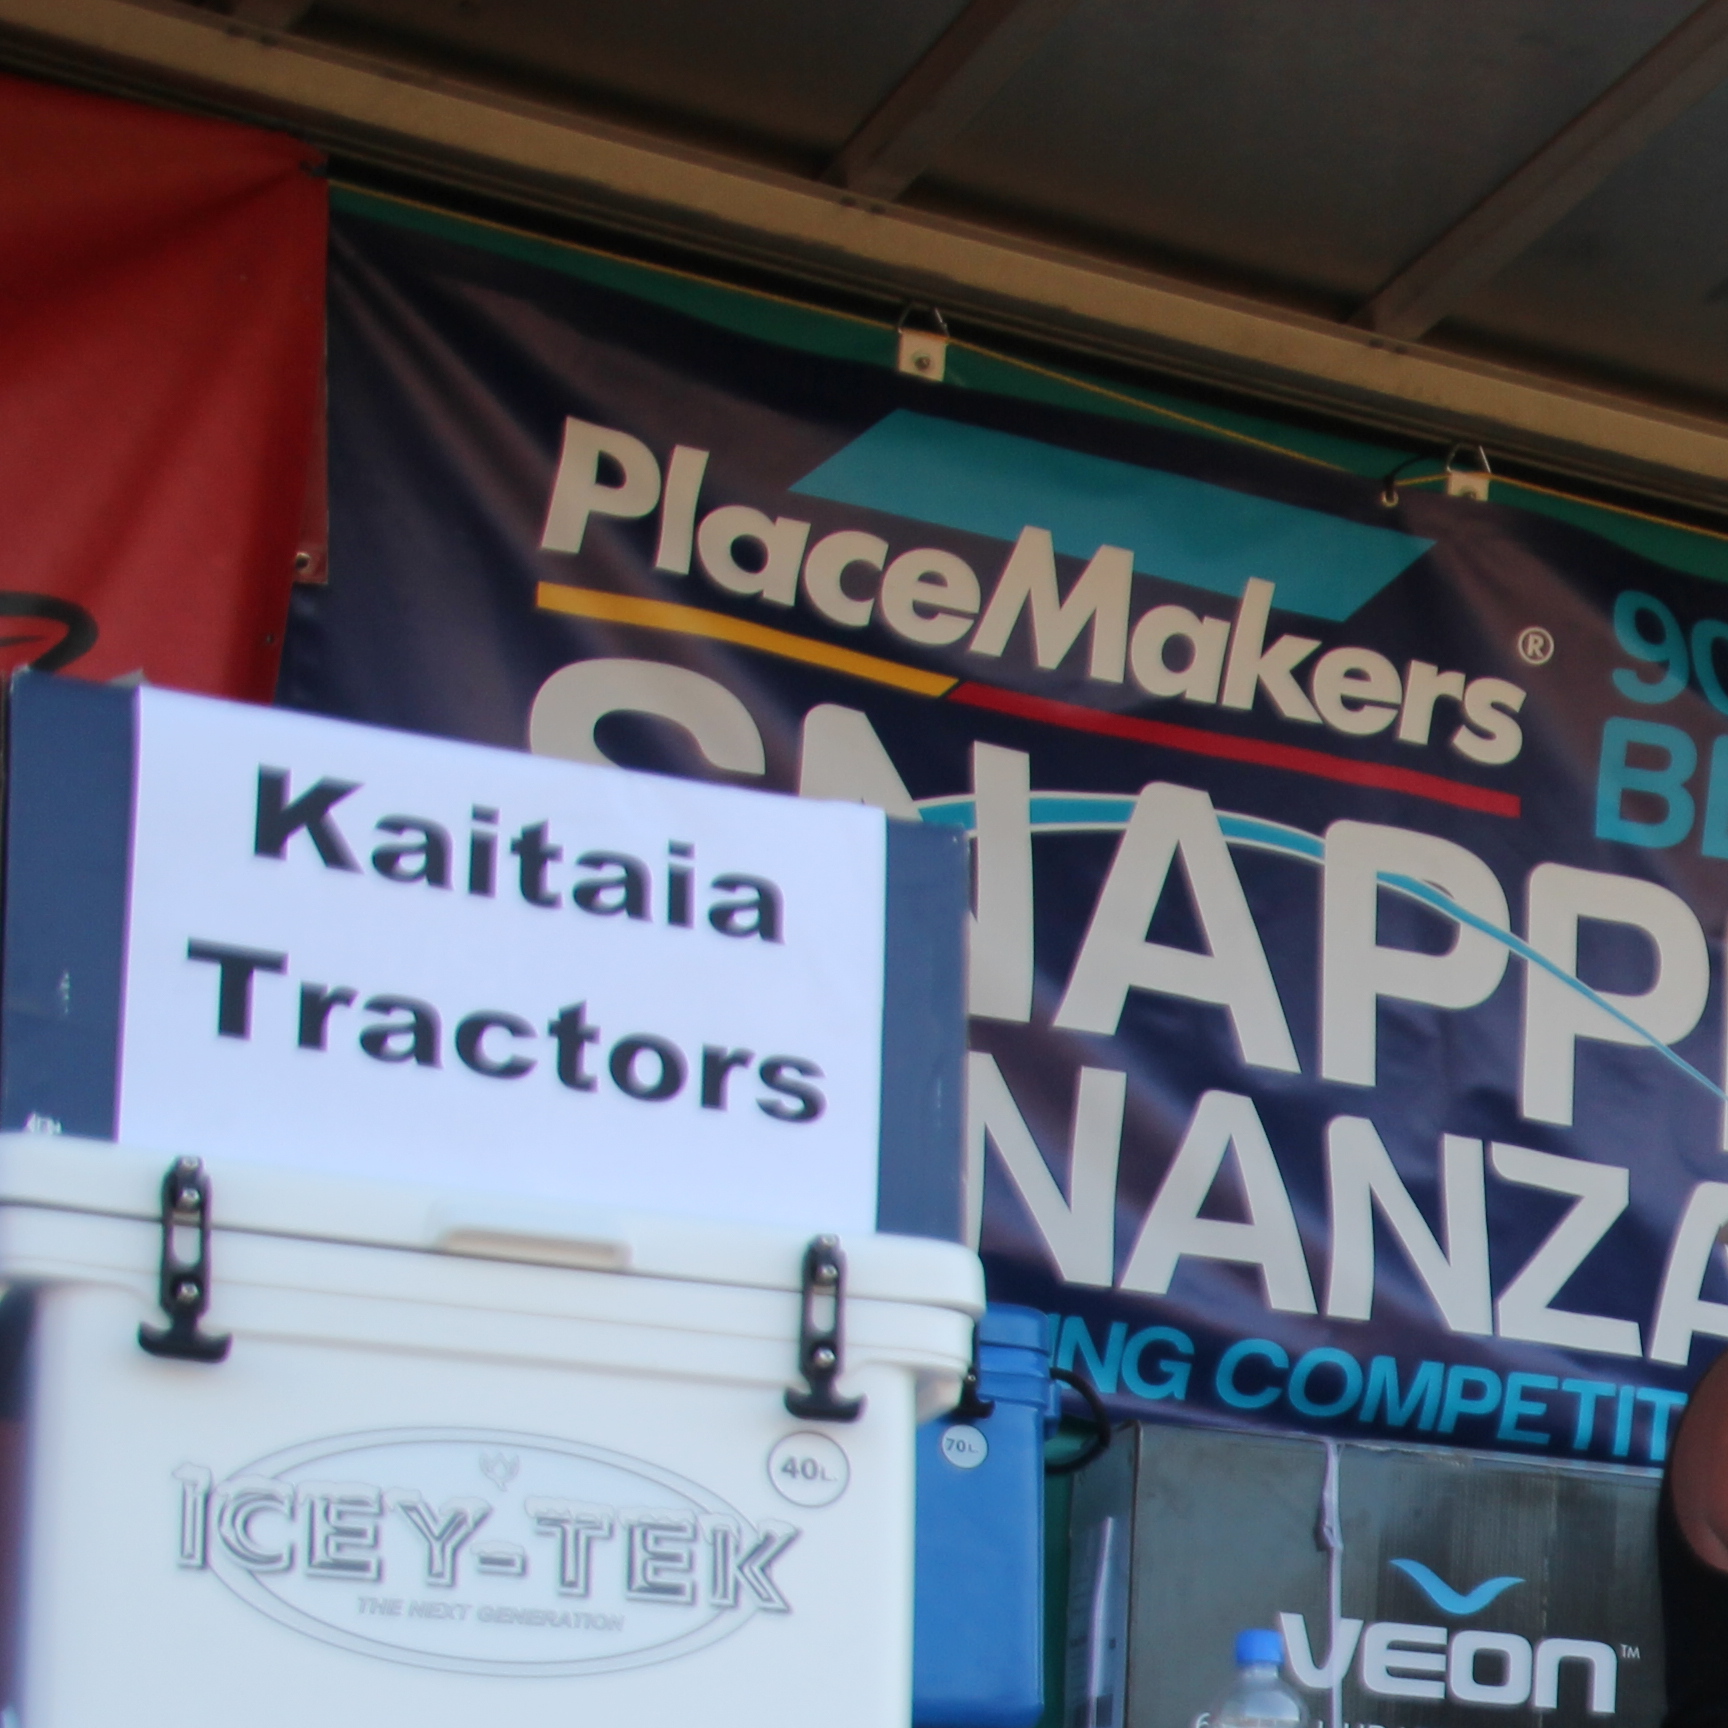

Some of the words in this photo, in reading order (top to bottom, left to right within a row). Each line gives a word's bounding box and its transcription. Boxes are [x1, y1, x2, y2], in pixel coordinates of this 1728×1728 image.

[540, 416, 1526, 763] PlaceMakers
[252, 765, 785, 945] Kaitaia
[186, 938, 827, 1125] Tractors
[1216, 1340, 1688, 1463] COMPETIT
[170, 1460, 801, 1613] ICEY-TEK
[357, 1597, 403, 1619] THE
[408, 1599, 471, 1624] NEXT
[476, 1603, 625, 1634] GENERATION
